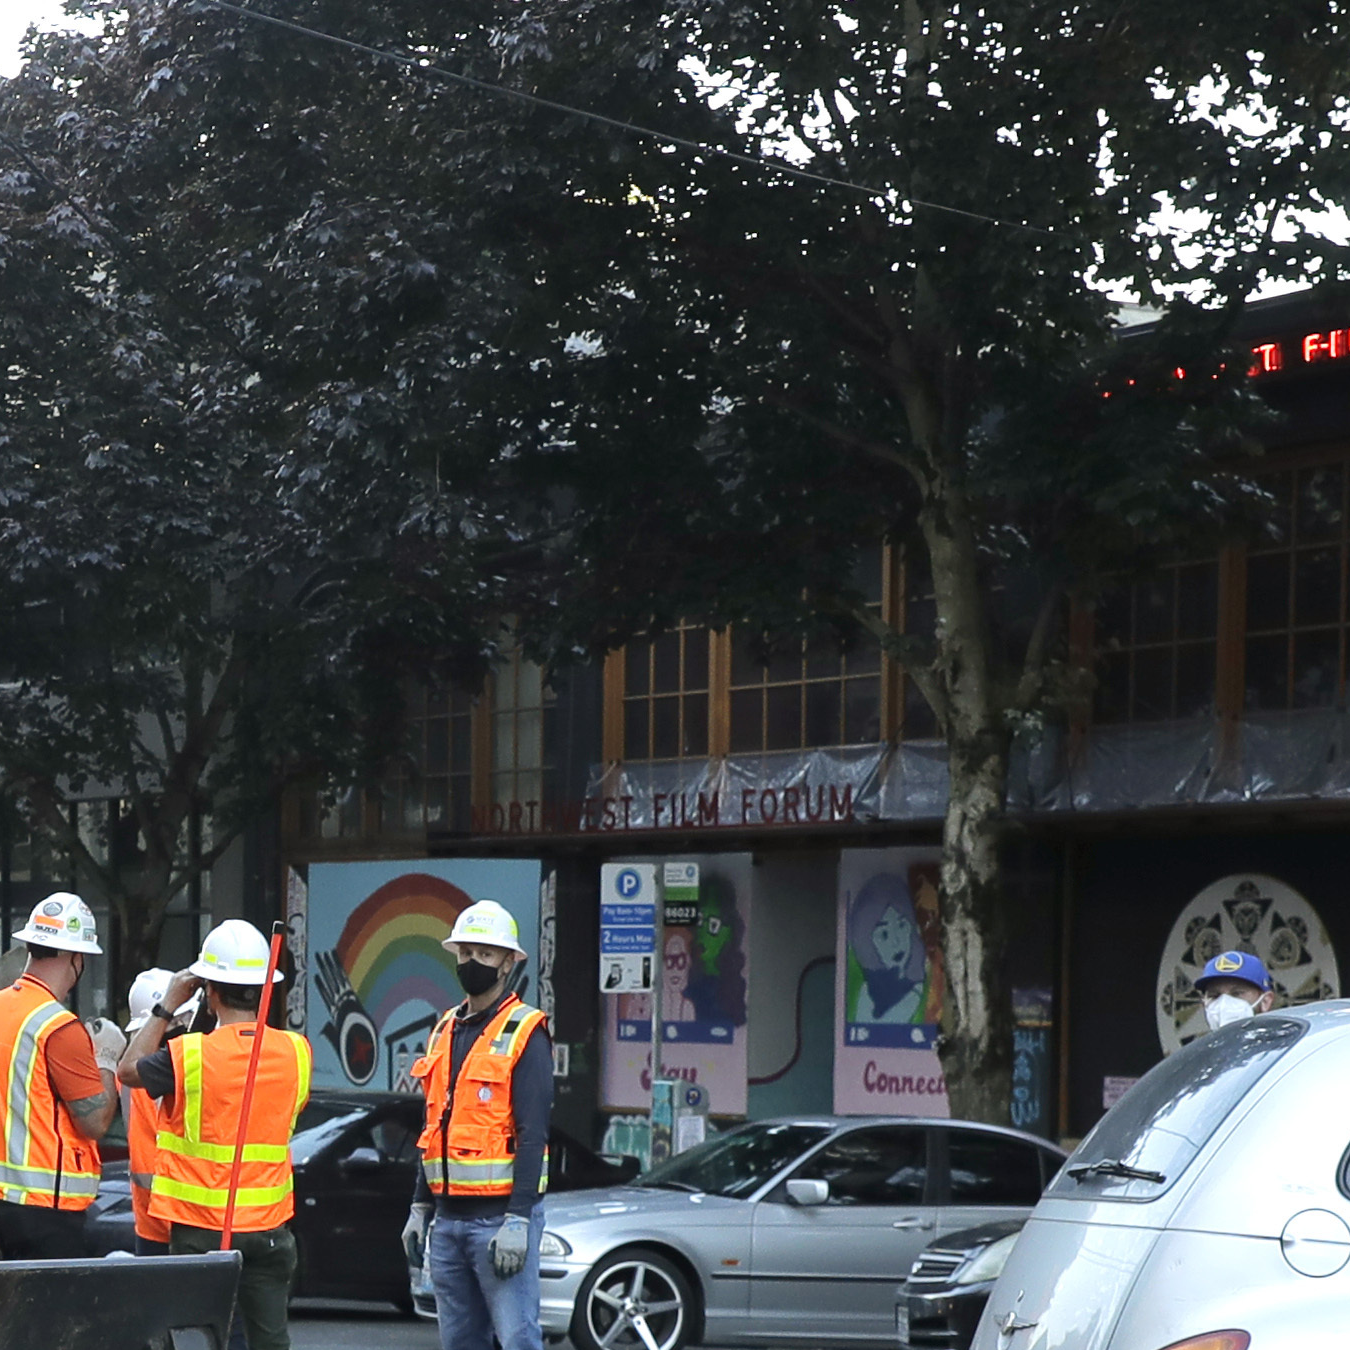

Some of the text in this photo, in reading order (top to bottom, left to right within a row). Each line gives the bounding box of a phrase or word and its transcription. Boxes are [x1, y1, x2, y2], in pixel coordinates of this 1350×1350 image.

[653, 791, 719, 828] FILM
[740, 782, 852, 824] FORUM
[603, 930, 611, 944] 2
